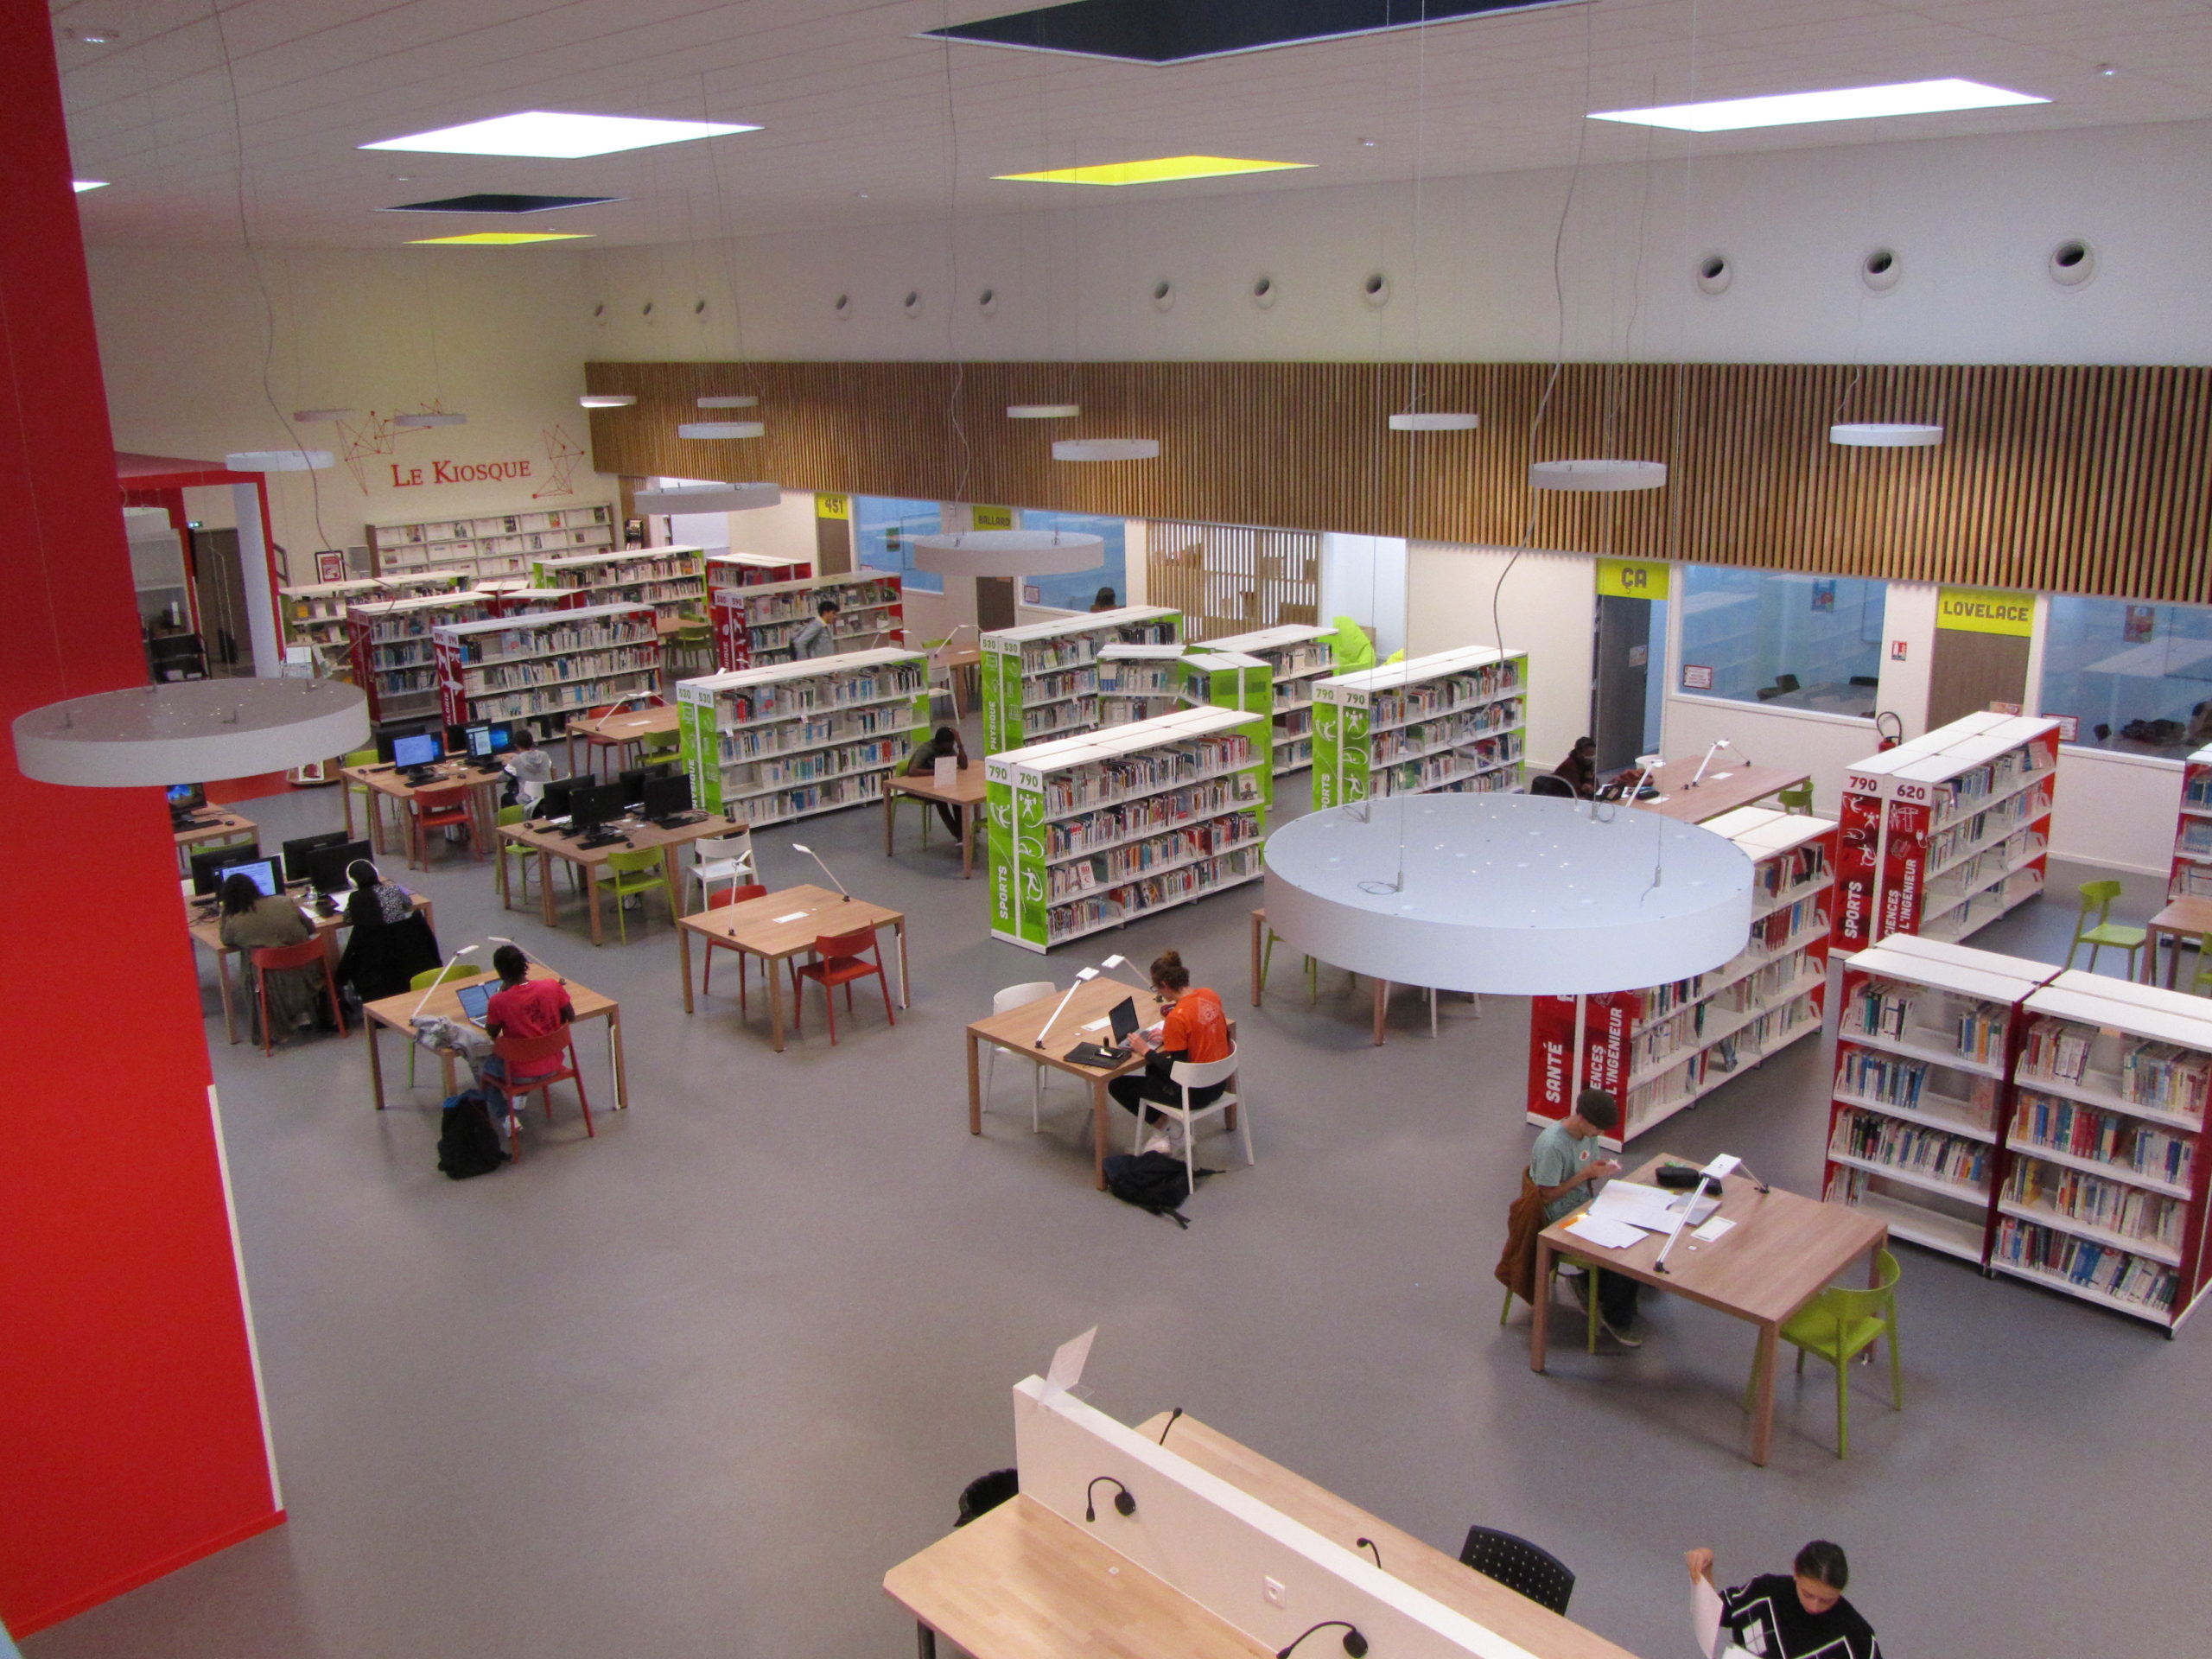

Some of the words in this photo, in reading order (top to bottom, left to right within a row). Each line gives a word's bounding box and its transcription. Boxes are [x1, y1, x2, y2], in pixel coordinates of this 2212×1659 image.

[825, 498, 843, 513] 451
[978, 515, 1010, 526] BALLARD
[1621, 567, 1647, 594] ÇA
[1942, 601, 2030, 622] LOVELACE
[982, 639, 996, 650] 530
[1003, 642, 1018, 653] 530
[678, 688, 691, 699] 530
[698, 692, 711, 704] 530
[1315, 688, 1334, 700] 790
[1346, 693, 1365, 705] 790
[988, 701, 998, 751] PHYSIQUE
[988, 765, 1007, 780] 790
[1019, 772, 1039, 788] 790
[689, 759, 697, 810] HYSIQUE
[1849, 776, 1878, 791] 790
[1321, 773, 1331, 810] PORTS
[1897, 785, 1925, 800] 620
[998, 866, 1008, 920] SPORTS
[1844, 881, 1863, 939] SPORTS
[1885, 889, 1900, 937] CIENCES
[1542, 1041, 1563, 1103] SANTÉ
[1590, 1044, 1605, 1090] ENCES
